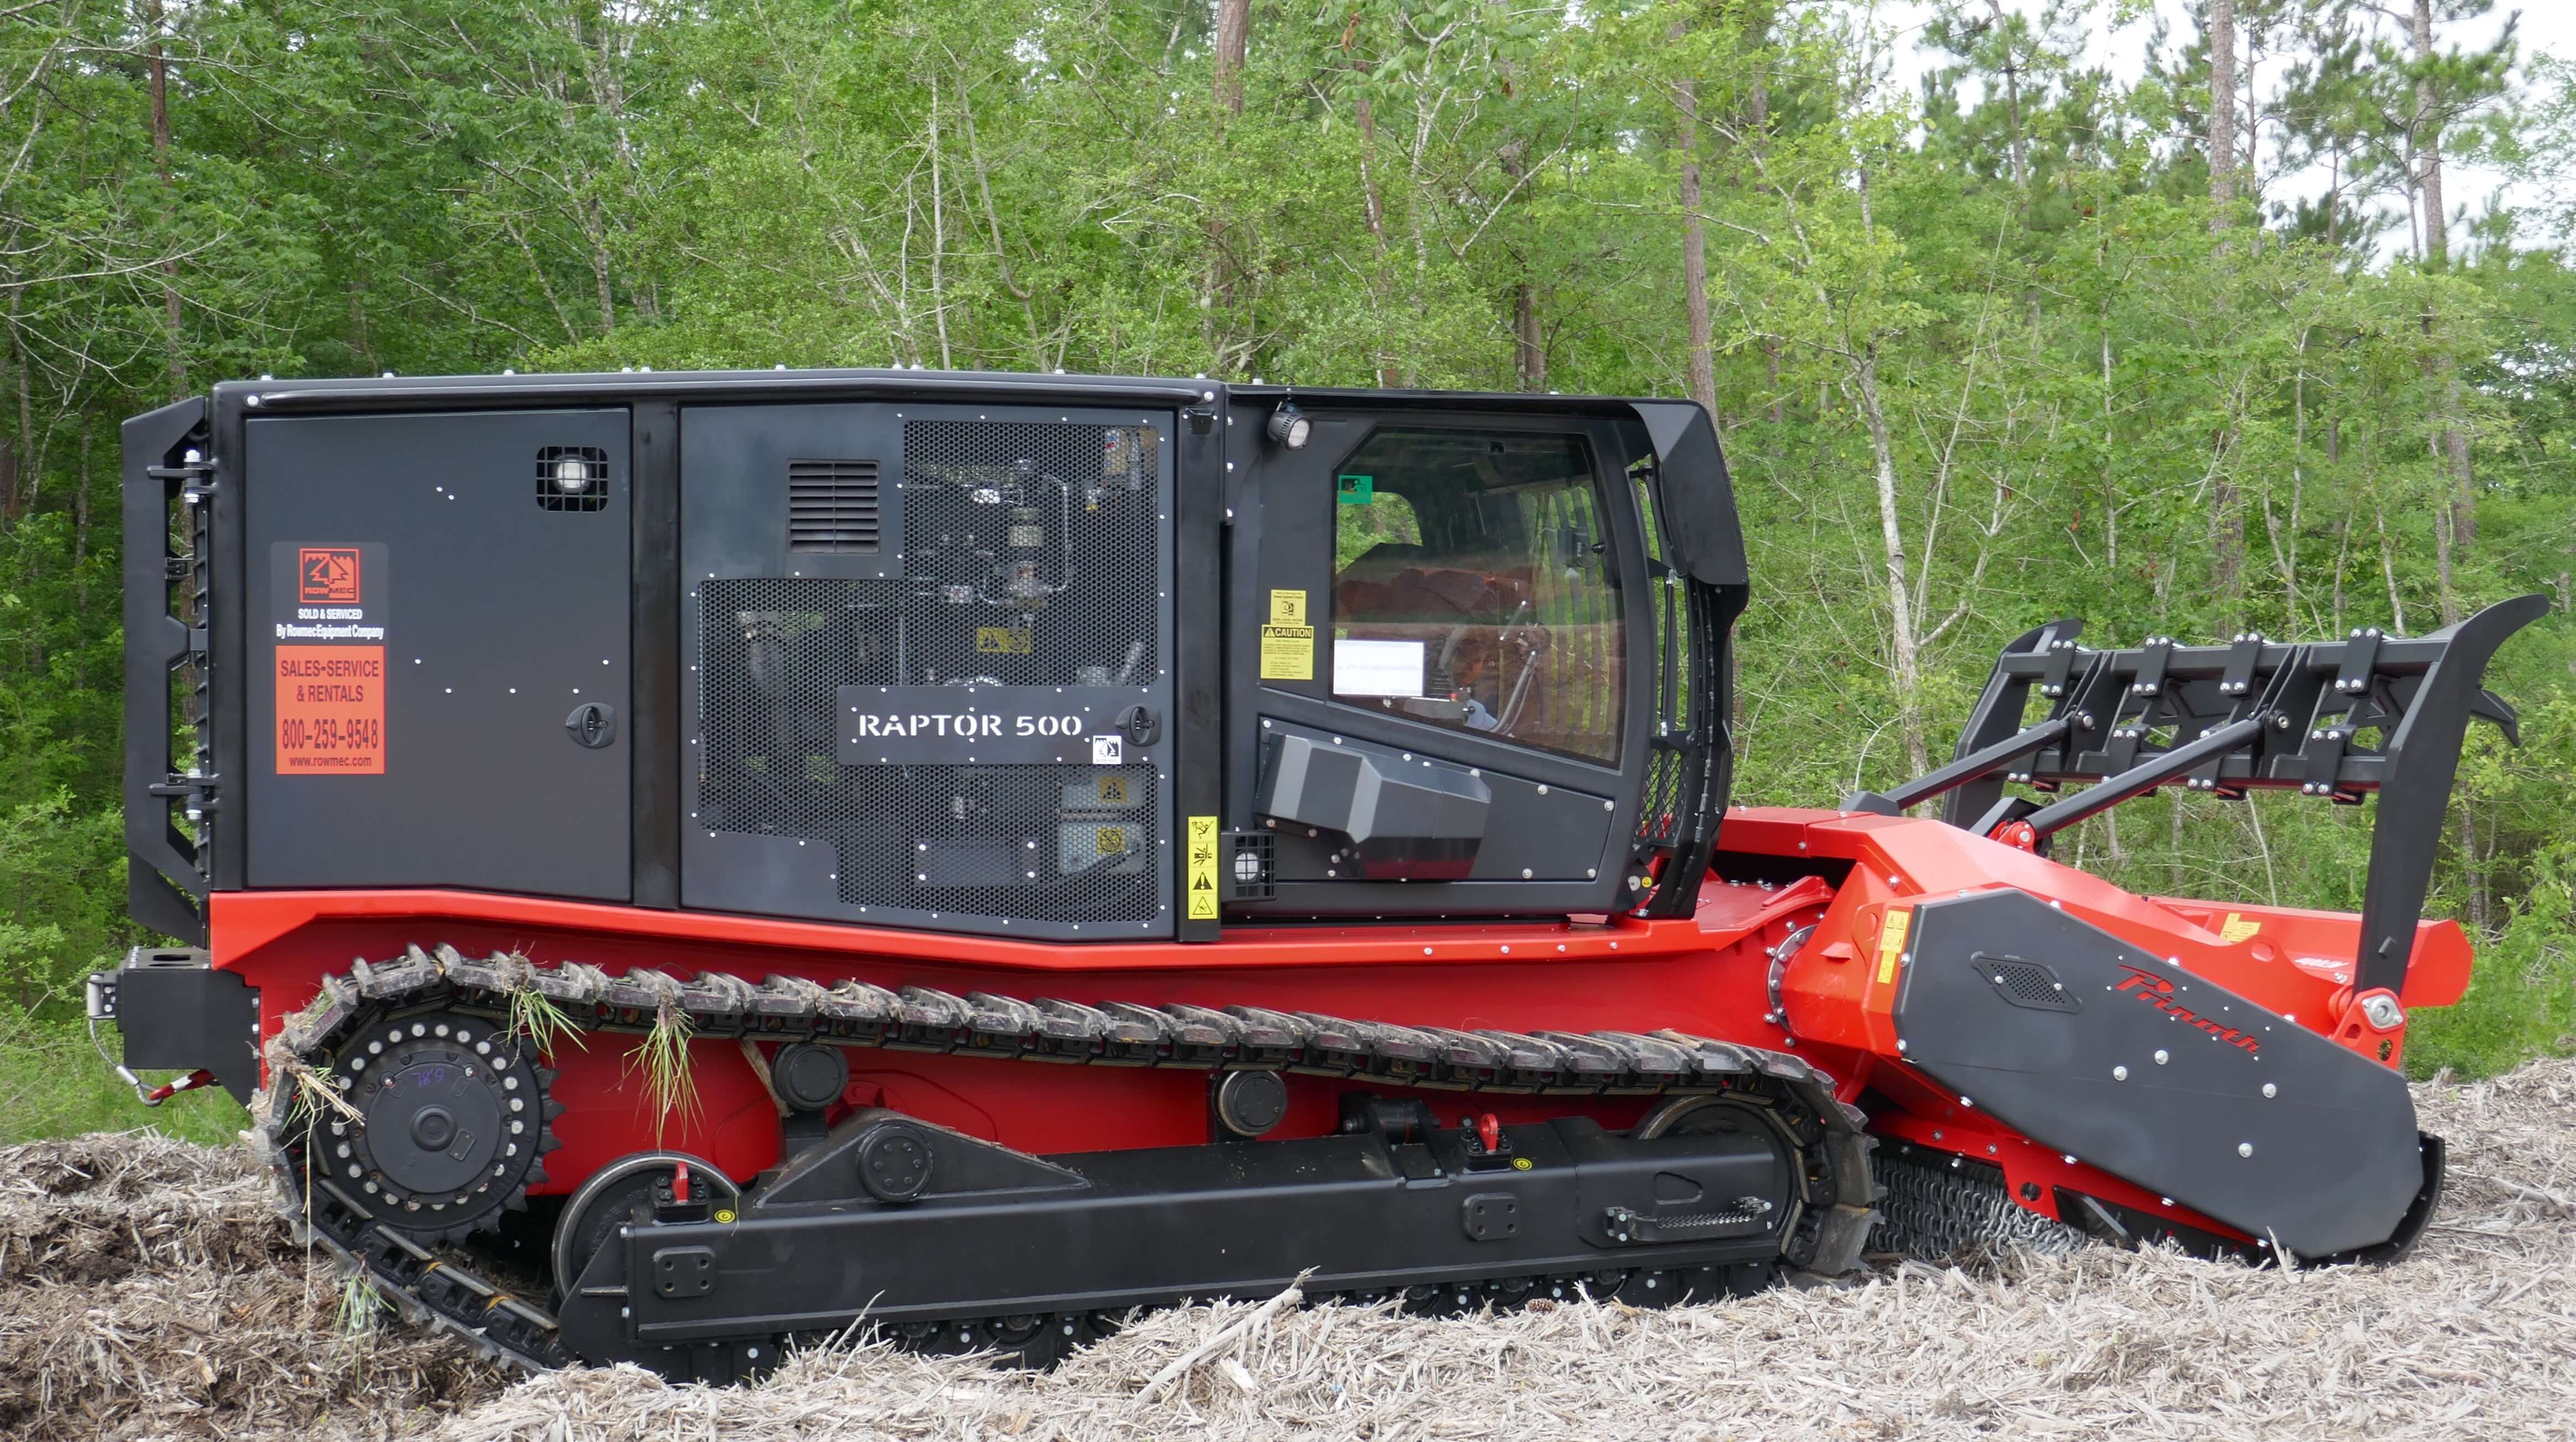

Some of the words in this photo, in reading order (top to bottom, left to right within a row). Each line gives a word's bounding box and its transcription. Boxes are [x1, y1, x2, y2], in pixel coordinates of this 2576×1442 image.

[298, 608, 319, 619] SOLD
[320, 609, 325, 619] &
[327, 609, 363, 619] SERVICED
[276, 624, 286, 639] By
[287, 625, 316, 637] Rowmec
[317, 626, 352, 639] Equipment
[352, 626, 384, 639] Company
[1275, 628, 1311, 637] CAUTION
[297, 685, 304, 702] &
[308, 685, 364, 702] RENTALS
[859, 715, 1002, 736] RAPTOR
[1016, 715, 1082, 736] 500
[282, 719, 379, 749] 800-259-9548
[289, 757, 372, 767] www.rowmec.com
